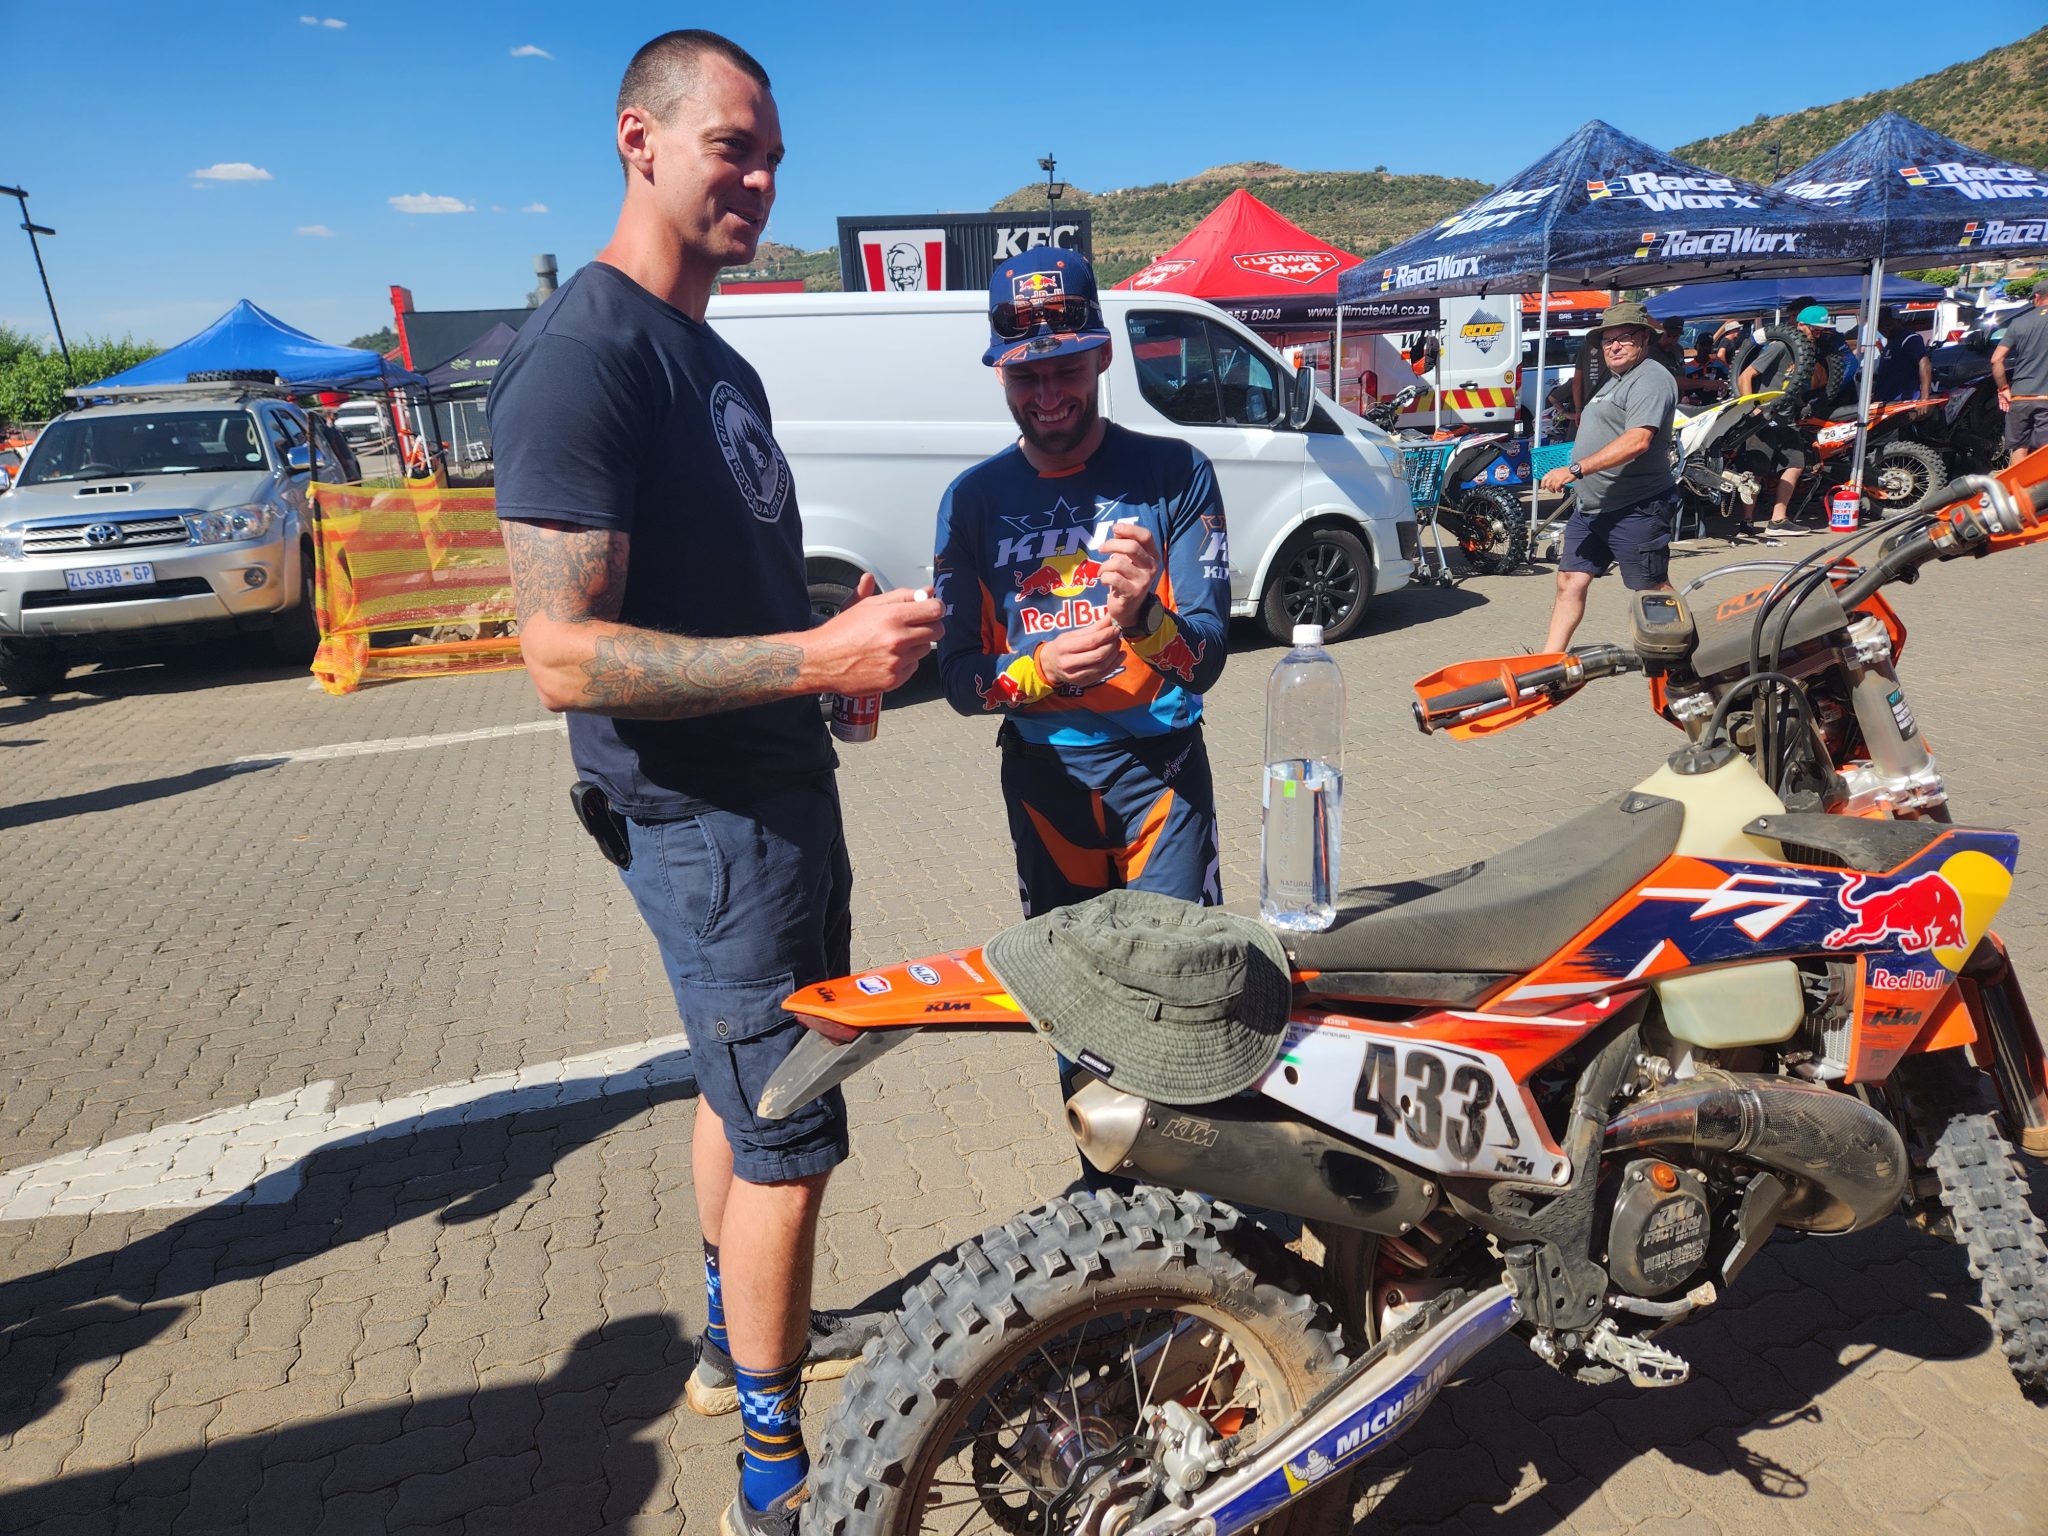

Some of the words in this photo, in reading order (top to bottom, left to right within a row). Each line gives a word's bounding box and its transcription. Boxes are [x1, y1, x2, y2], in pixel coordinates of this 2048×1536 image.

[1926, 163, 2038, 182] Race
[1621, 172, 1737, 194] Race
[1606, 191, 1761, 211] Worx
[1661, 227, 1801, 257] RaceWorx
[1250, 254, 1323, 265] ULTIMATE
[1268, 262, 1322, 274] 4x4
[1396, 256, 1482, 288] RaceWorx
[1251, 309, 1281, 321] 0404
[1307, 304, 1430, 318] www.ltimate4x4.co.za
[1460, 323, 1505, 338] ROOF
[475, 359, 500, 368] END
[715, 411, 730, 443] RIDE
[733, 461, 773, 518] ROTOUA,
[994, 516, 1139, 568] KIN
[68, 568, 122, 587] ZLS838
[133, 566, 150, 580] GP
[1020, 600, 1072, 634] Red
[1073, 600, 1110, 627] Bu
[1280, 879, 1312, 888] NATURAL
[1873, 969, 1912, 988] Red
[1912, 969, 1945, 989] Bull
[925, 1002, 971, 1012] KTM
[1869, 1006, 1922, 1025] KTM
[1352, 1041, 1495, 1162] 433
[1161, 1117, 1219, 1147] KTM
[1494, 1155, 1535, 1175] KTM
[1336, 1360, 1447, 1456] MICHELIN
